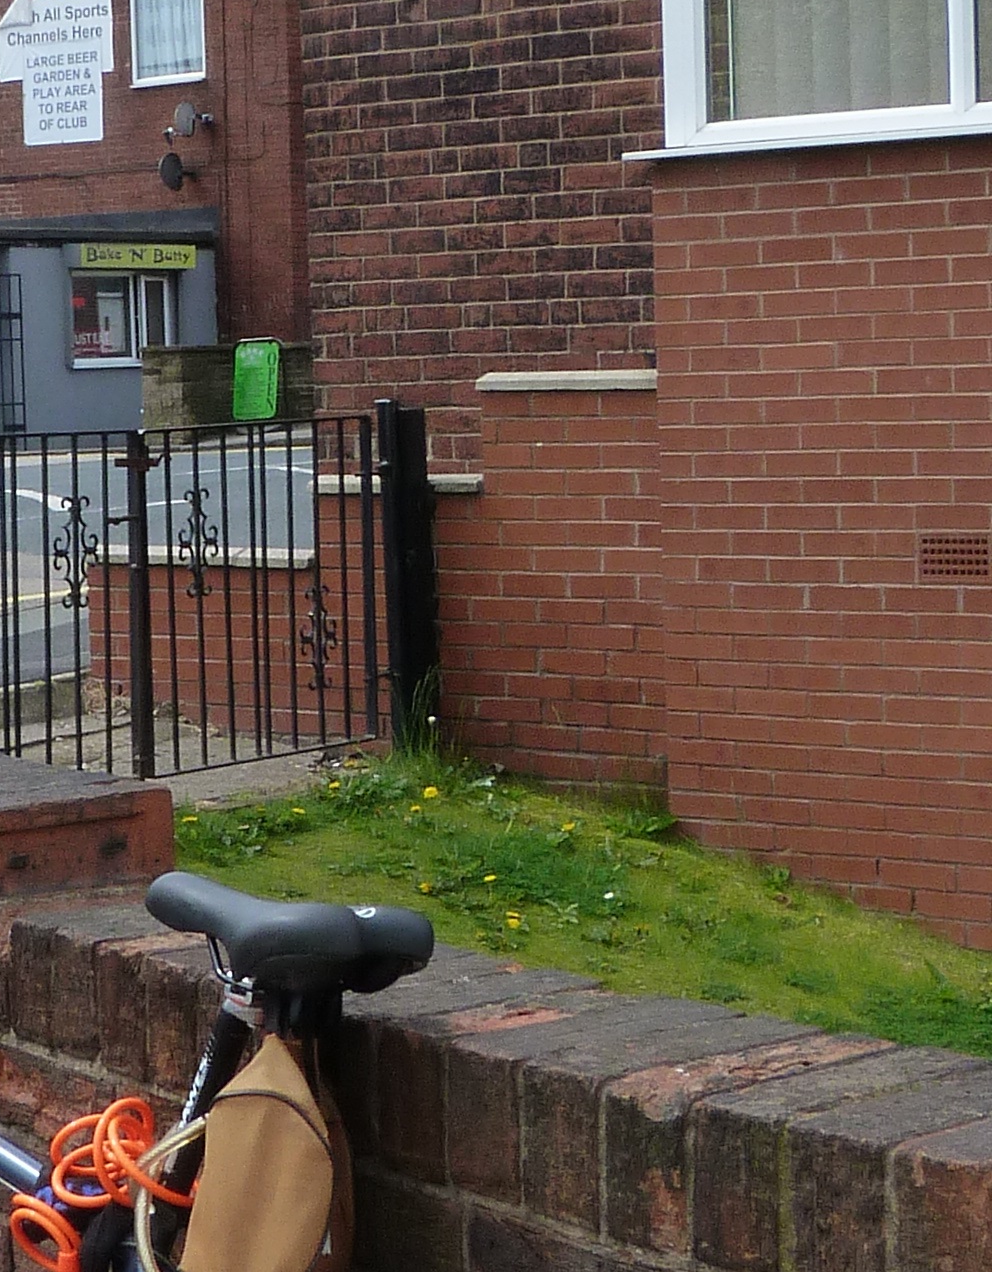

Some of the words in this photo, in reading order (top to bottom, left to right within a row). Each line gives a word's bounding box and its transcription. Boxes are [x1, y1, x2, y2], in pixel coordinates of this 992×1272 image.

[43, 7, 61, 23] All
[64, 4, 109, 22] Sports
[7, 27, 68, 47] Channels
[72, 25, 103, 39] Here
[26, 54, 65, 69] LARGE
[67, 51, 98, 64] BEER
[33, 69, 80, 83] GARDEN
[83, 68, 91, 80] &
[33, 86, 61, 99] PLAY
[64, 83, 96, 96] AREA
[38, 103, 53, 114] TO
[56, 100, 88, 113] REAR
[39, 119, 55, 131] OF
[57, 116, 87, 129] CLUB
[153, 248, 190, 264] Butty
